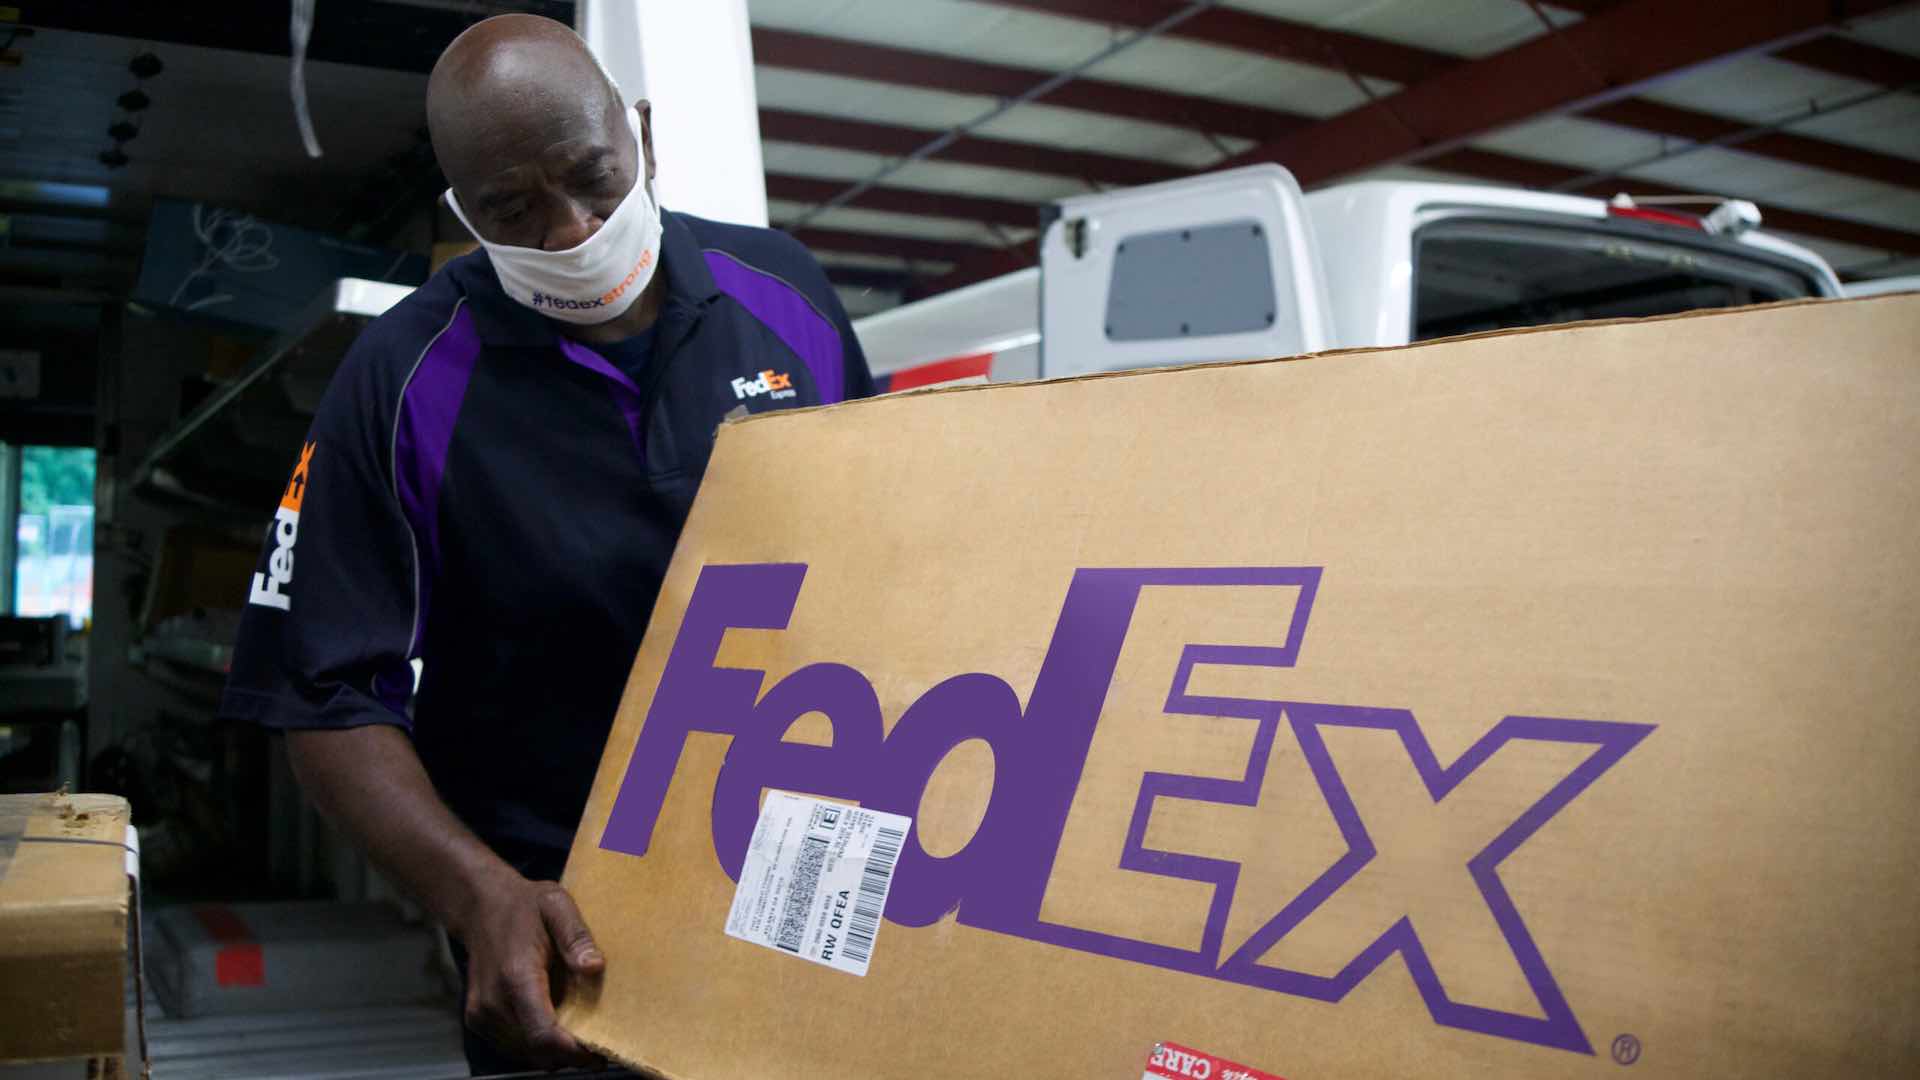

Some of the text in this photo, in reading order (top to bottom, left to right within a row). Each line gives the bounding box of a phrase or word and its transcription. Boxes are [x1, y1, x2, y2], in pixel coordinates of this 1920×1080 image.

[730, 369, 792, 400] FedEx
[599, 563, 1657, 1056] FedEx
[821, 934, 838, 961] RW
[831, 890, 850, 929] QFEA
